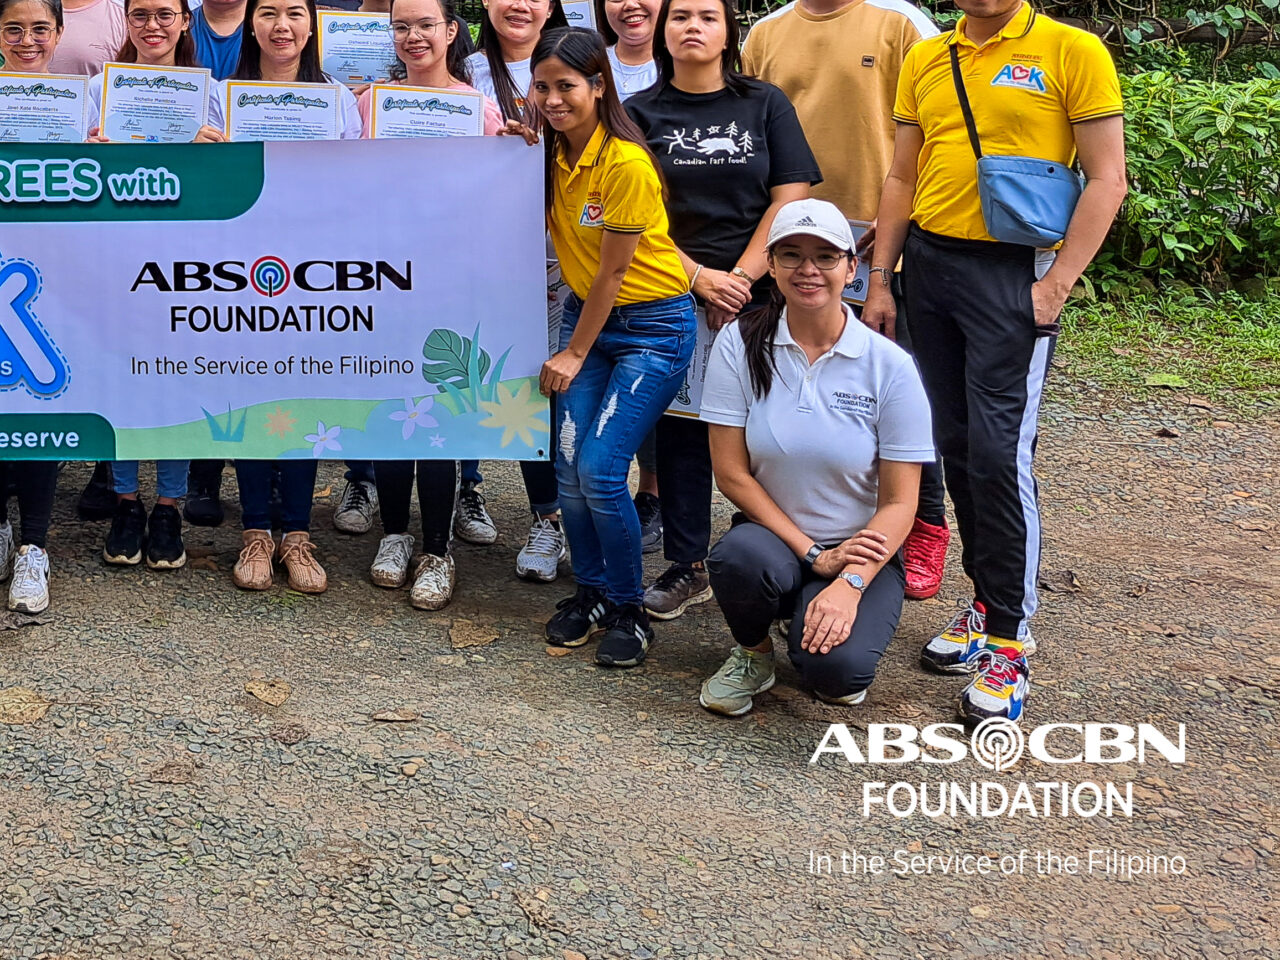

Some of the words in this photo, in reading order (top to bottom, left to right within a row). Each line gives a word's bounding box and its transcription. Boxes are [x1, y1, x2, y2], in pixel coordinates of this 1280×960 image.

[673, 157, 707, 165] Canadian
[107, 167, 181, 202] with
[170, 305, 374, 333] FOUNDATION
[130, 356, 149, 375] In
[155, 356, 188, 375] the
[194, 356, 269, 376] Service
[273, 355, 296, 375] of
[300, 355, 334, 375] the
[340, 355, 415, 378] Filipino
[836, 399, 871, 409] FOUNDATION
